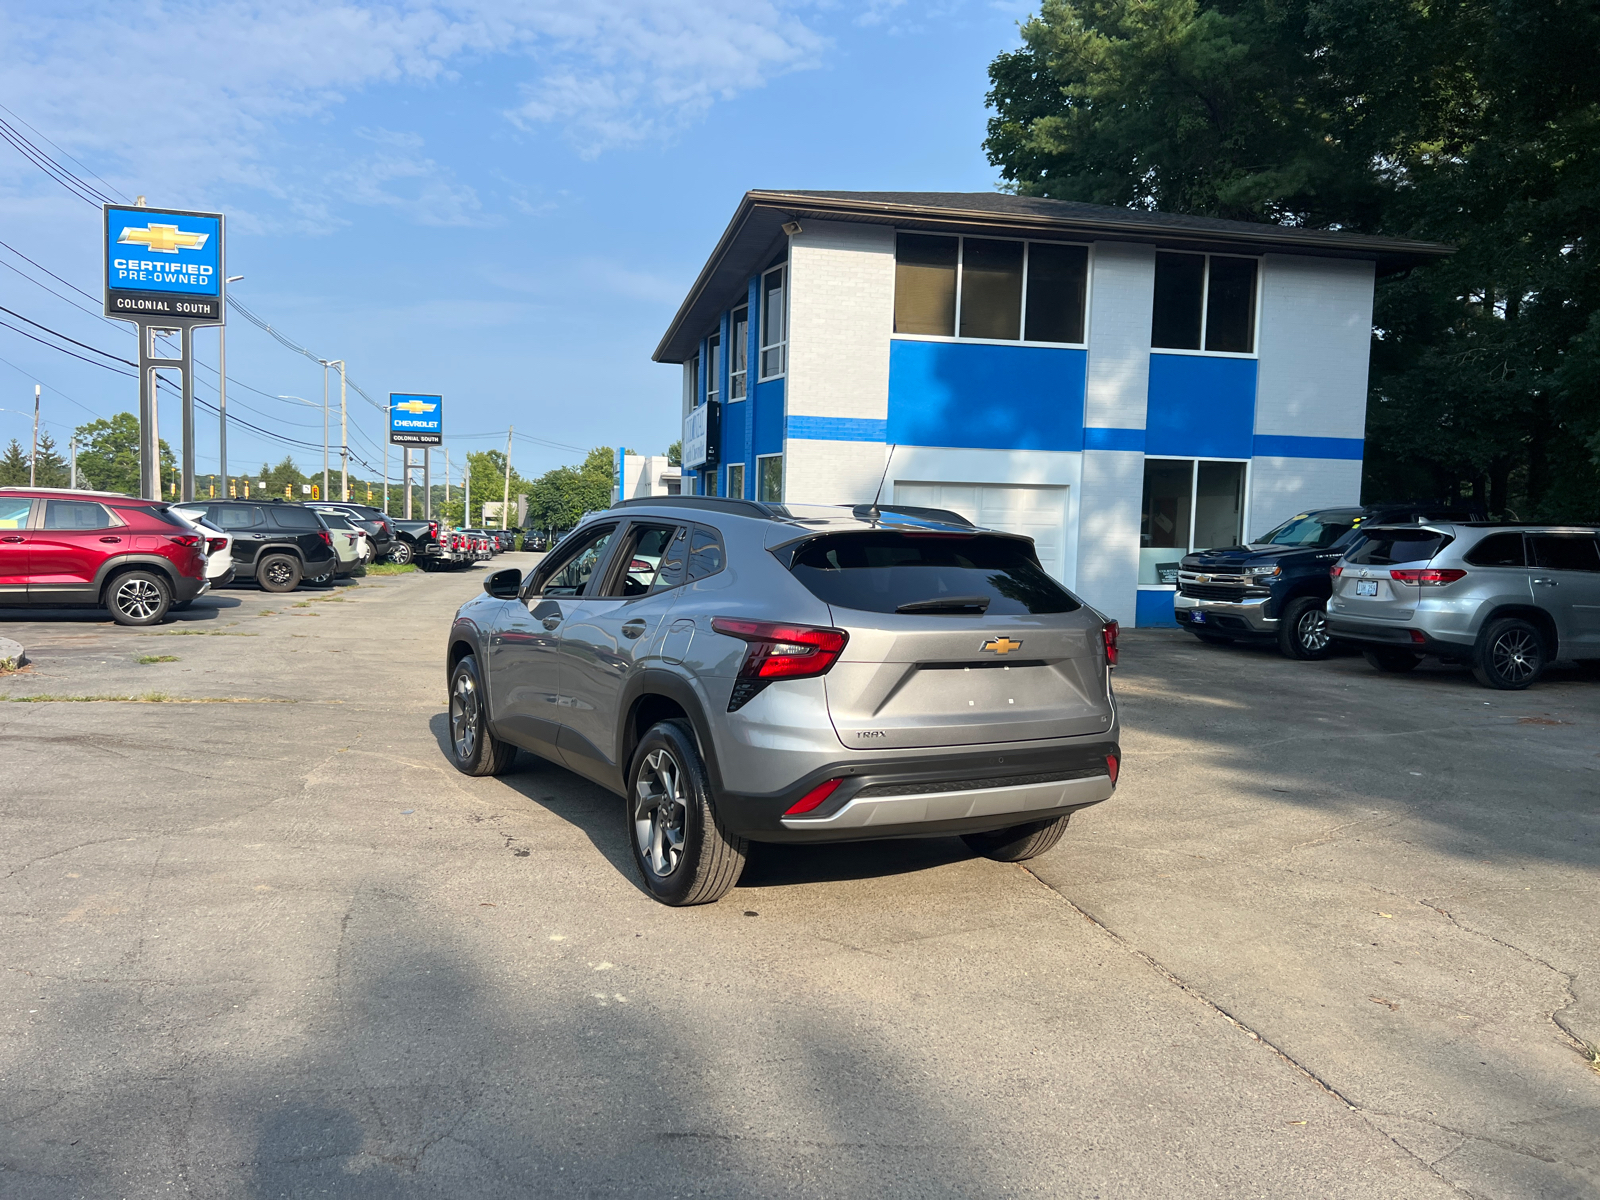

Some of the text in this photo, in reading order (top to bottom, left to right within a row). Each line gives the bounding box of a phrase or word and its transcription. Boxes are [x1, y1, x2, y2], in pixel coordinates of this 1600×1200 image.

[114, 259, 213, 275] CERTIFIED
[119, 270, 208, 285] PRE-OWNED
[117, 299, 211, 313] COLONIAL SOUTH
[394, 420, 438, 428] CHEVROLET
